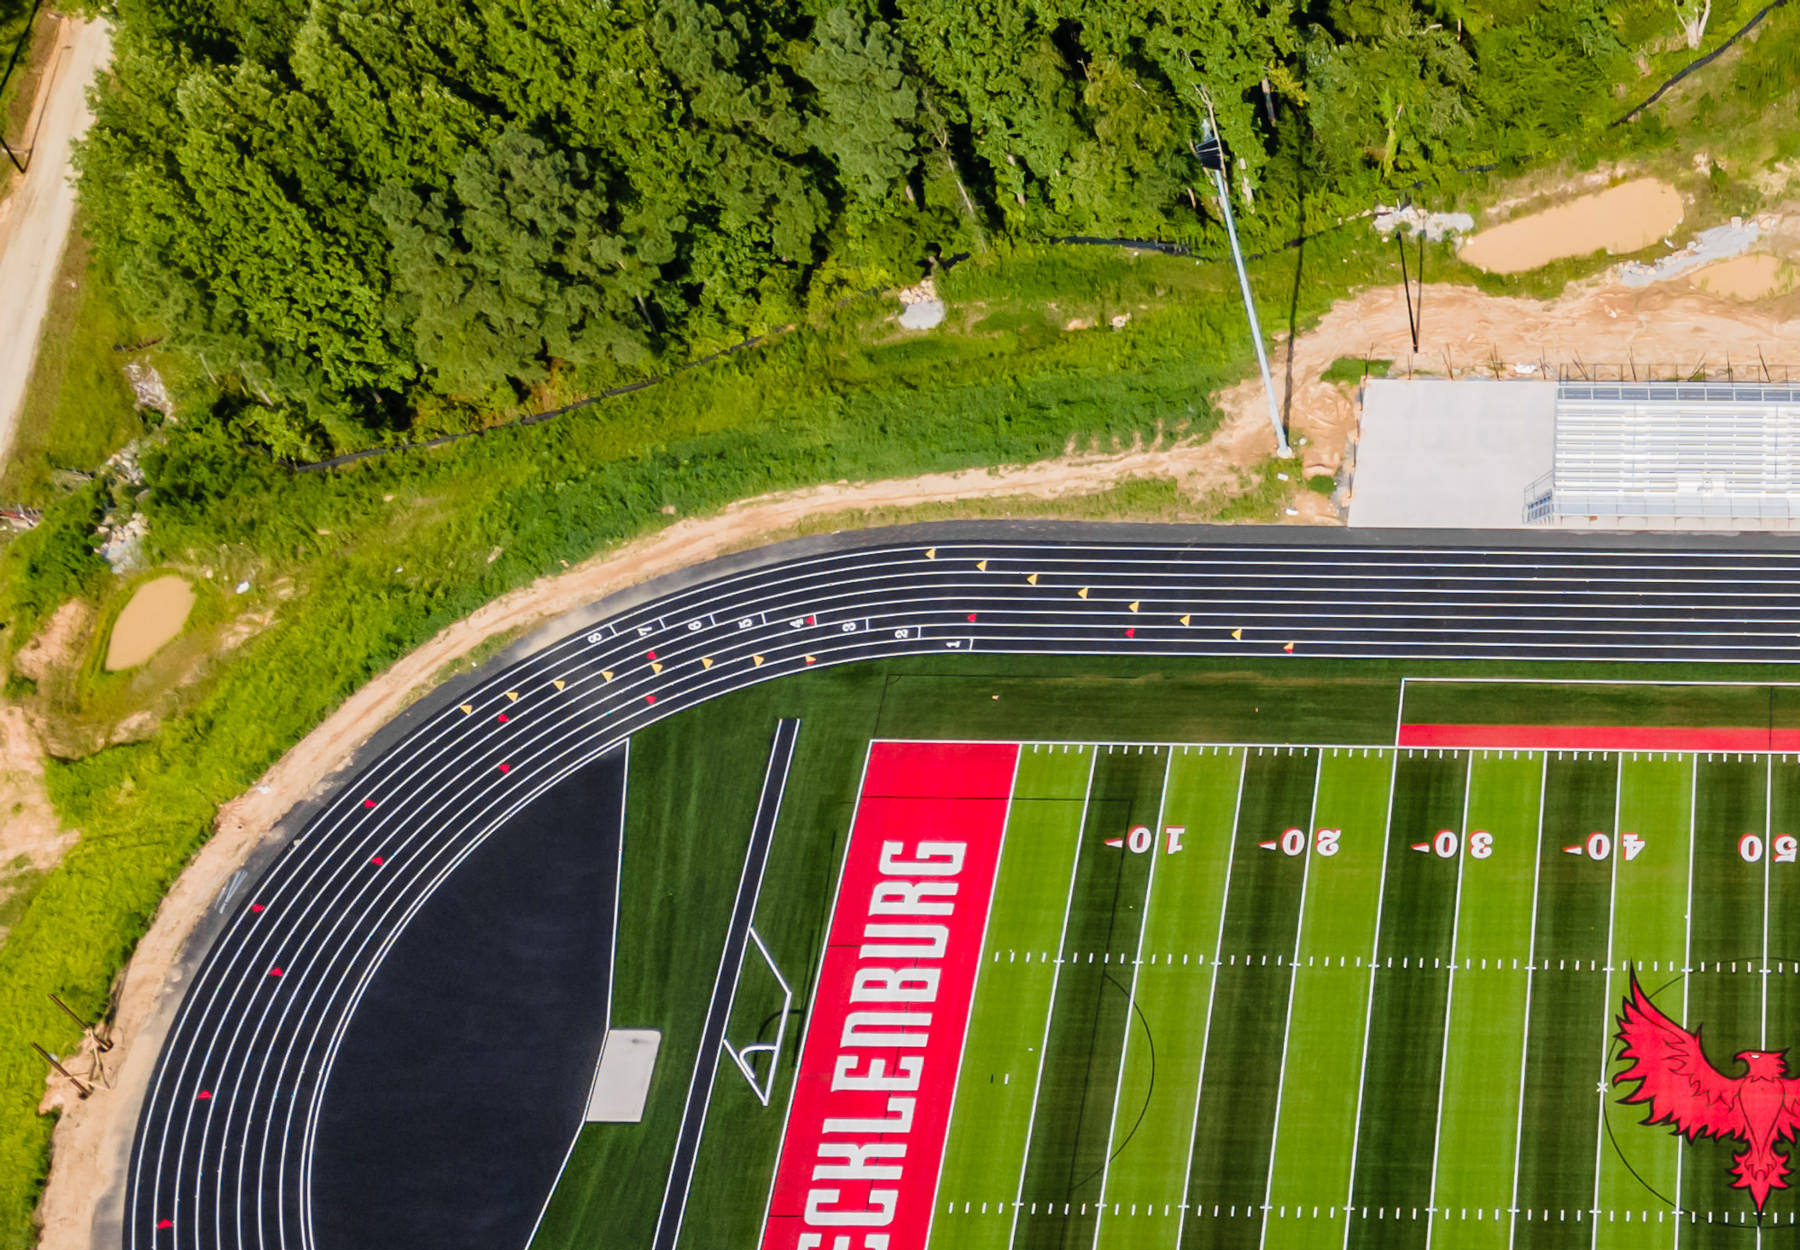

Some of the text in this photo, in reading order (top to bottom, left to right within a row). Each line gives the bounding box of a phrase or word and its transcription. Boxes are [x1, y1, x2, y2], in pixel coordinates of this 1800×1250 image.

[688, 621, 702, 630] 6
[738, 619, 752, 629] 5
[789, 619, 804, 628] 4
[842, 622, 856, 631] 3
[638, 627, 652, 636] 7
[895, 629, 908, 638] 2
[587, 633, 602, 644] 8
[1127, 825, 1187, 855] 10
[1281, 828, 1342, 857] 20
[1434, 830, 1494, 860] 30
[1587, 832, 1646, 862] 40
[1739, 834, 1798, 863] 50
